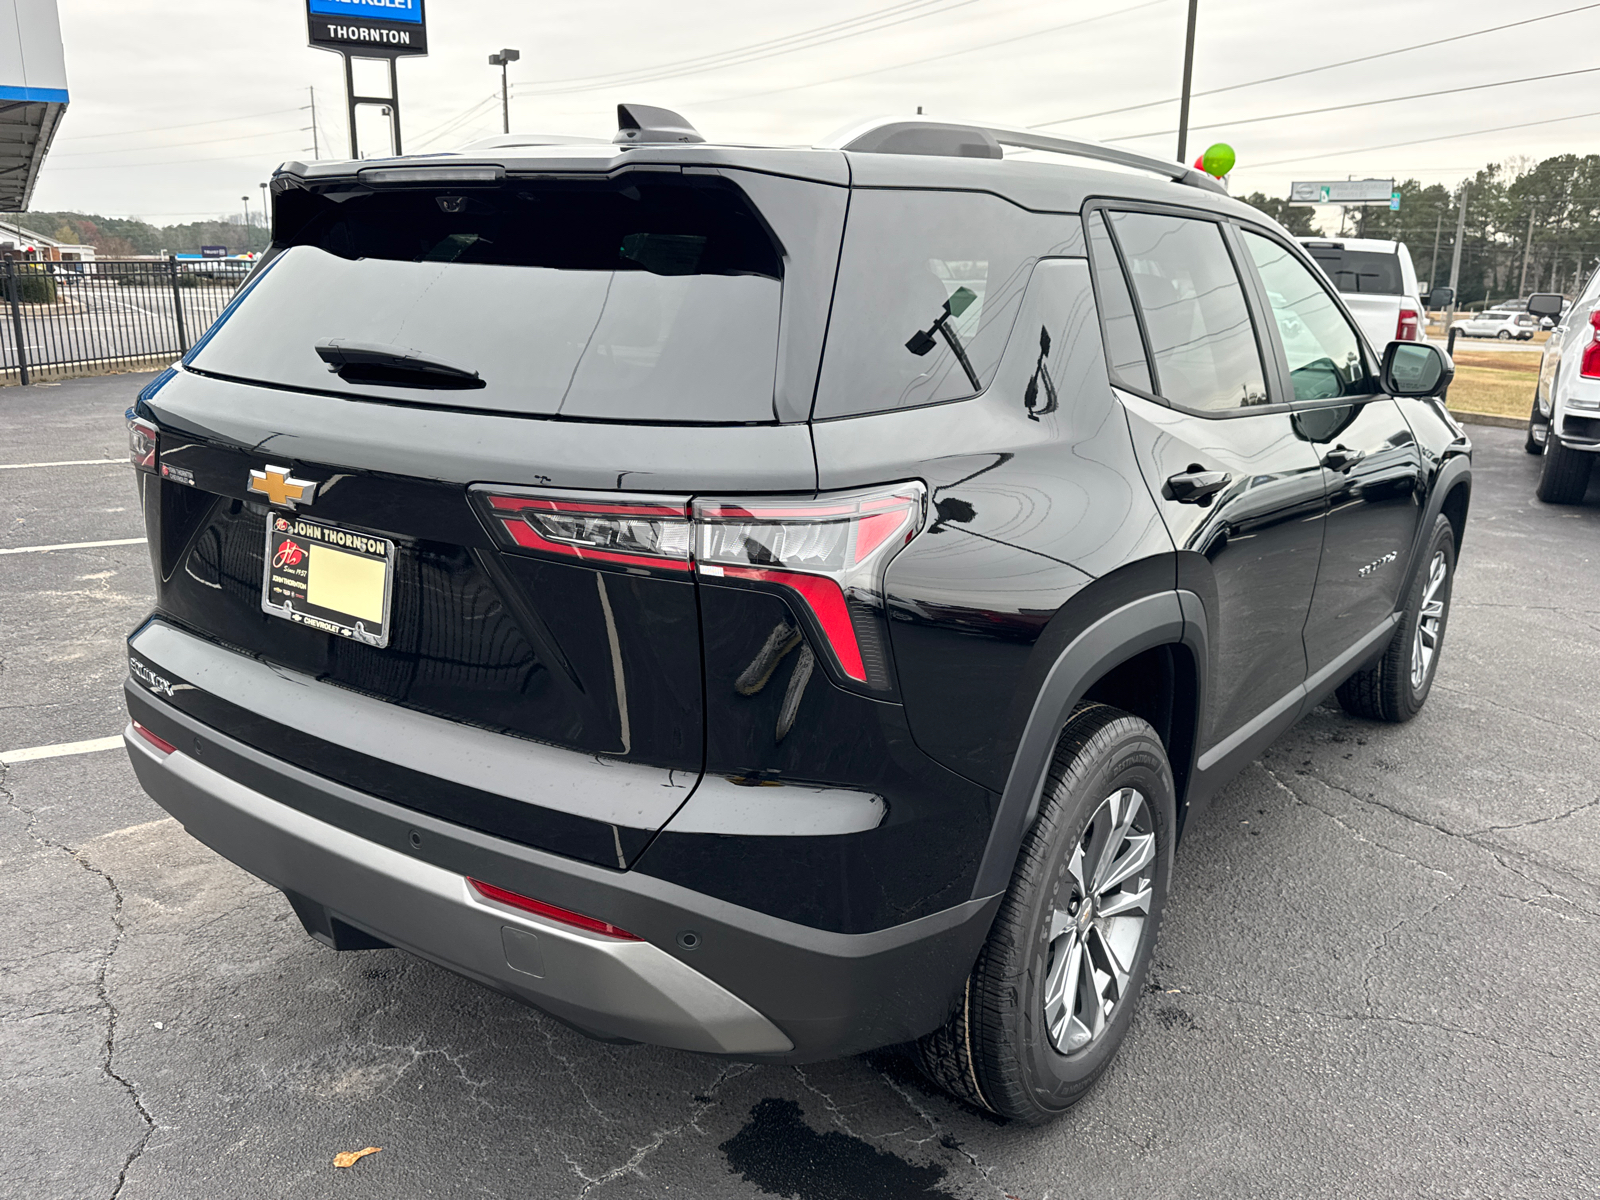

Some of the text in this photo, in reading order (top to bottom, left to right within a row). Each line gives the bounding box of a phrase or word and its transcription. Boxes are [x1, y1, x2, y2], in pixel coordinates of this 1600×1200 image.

[327, 24, 410, 44] THORNTON
[294, 521, 322, 539] JOHN
[303, 616, 339, 634] CHEVROLET
